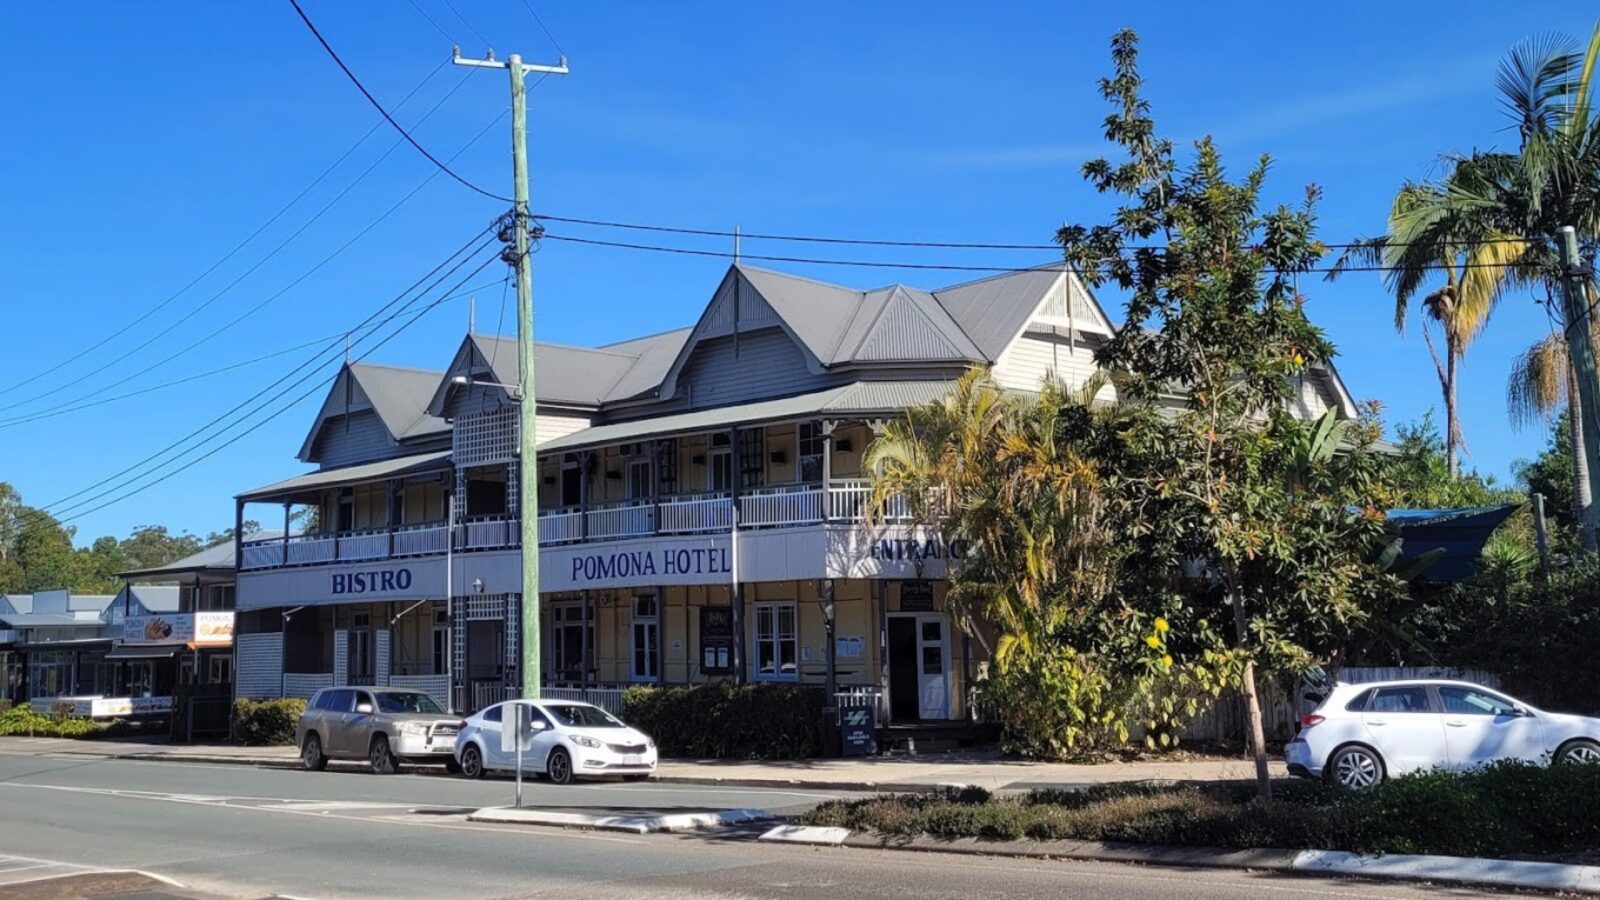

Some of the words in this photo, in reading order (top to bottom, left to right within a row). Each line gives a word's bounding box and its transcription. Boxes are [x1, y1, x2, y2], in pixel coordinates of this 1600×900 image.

[871, 539, 970, 560] ENTRANC
[572, 551, 657, 581] POMONA
[664, 548, 731, 575] HOTEL
[332, 568, 412, 594] BISTRO
